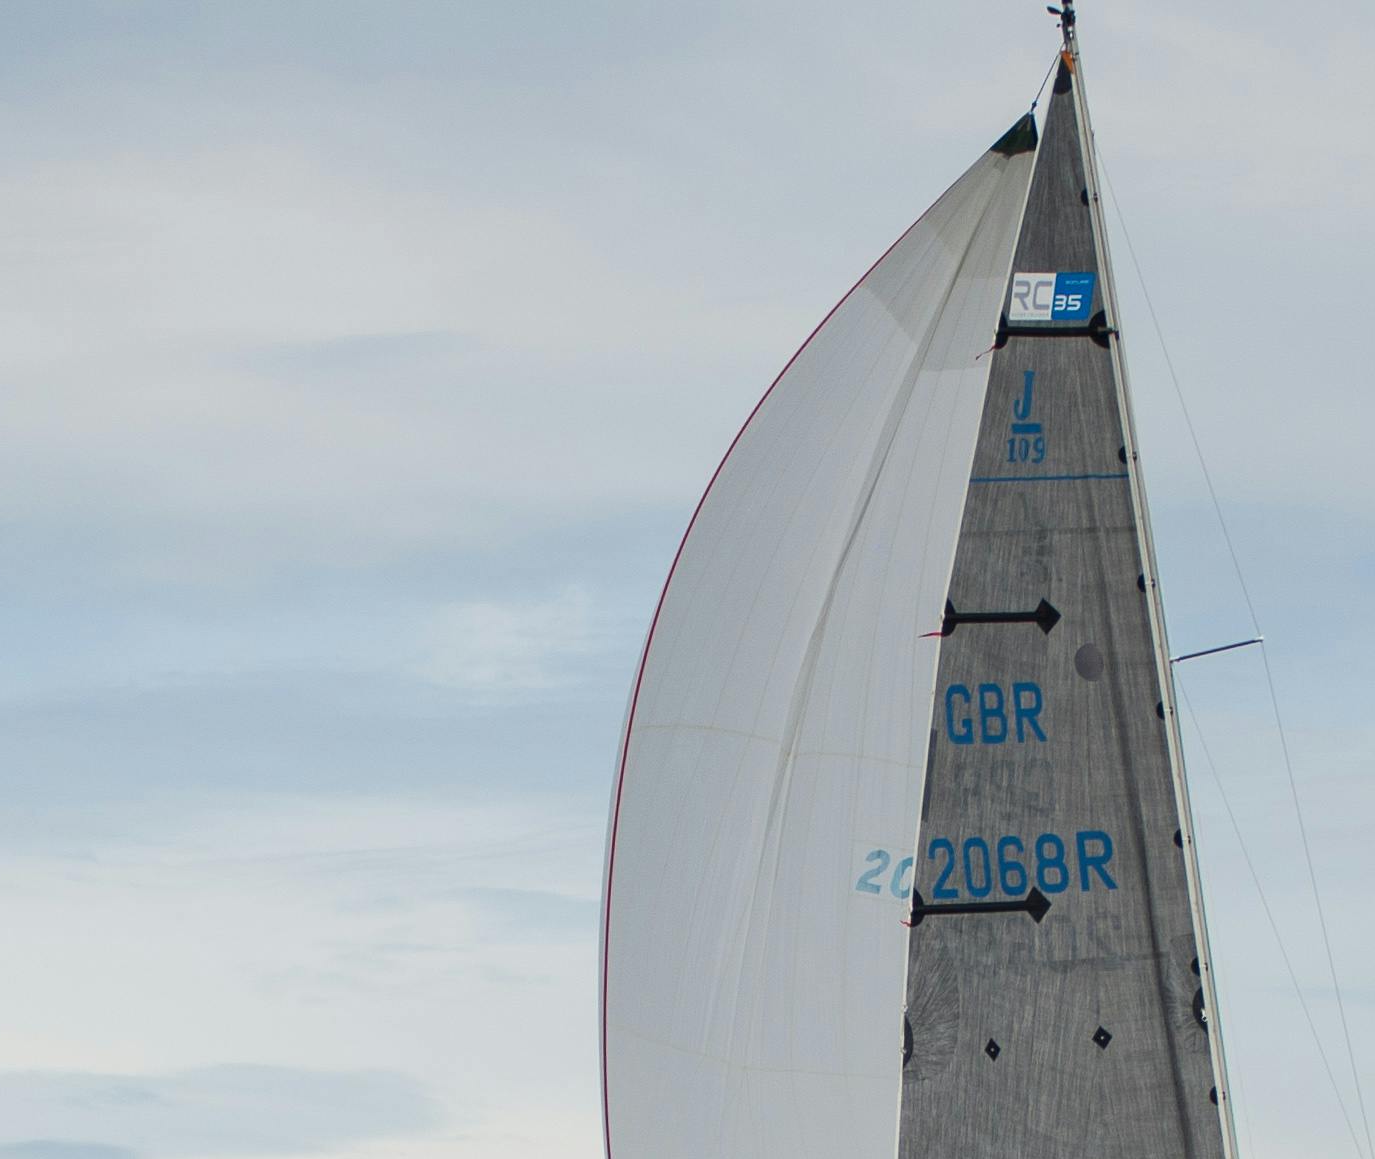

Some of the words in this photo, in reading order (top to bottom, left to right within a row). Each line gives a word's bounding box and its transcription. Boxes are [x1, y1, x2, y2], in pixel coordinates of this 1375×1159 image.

[1014, 280, 1053, 310] RC
[1054, 294, 1082, 310] 35
[1013, 370, 1035, 420] J
[1007, 437, 1045, 464] 109
[945, 682, 1047, 744] GBR
[928, 830, 1118, 899] 2068R
